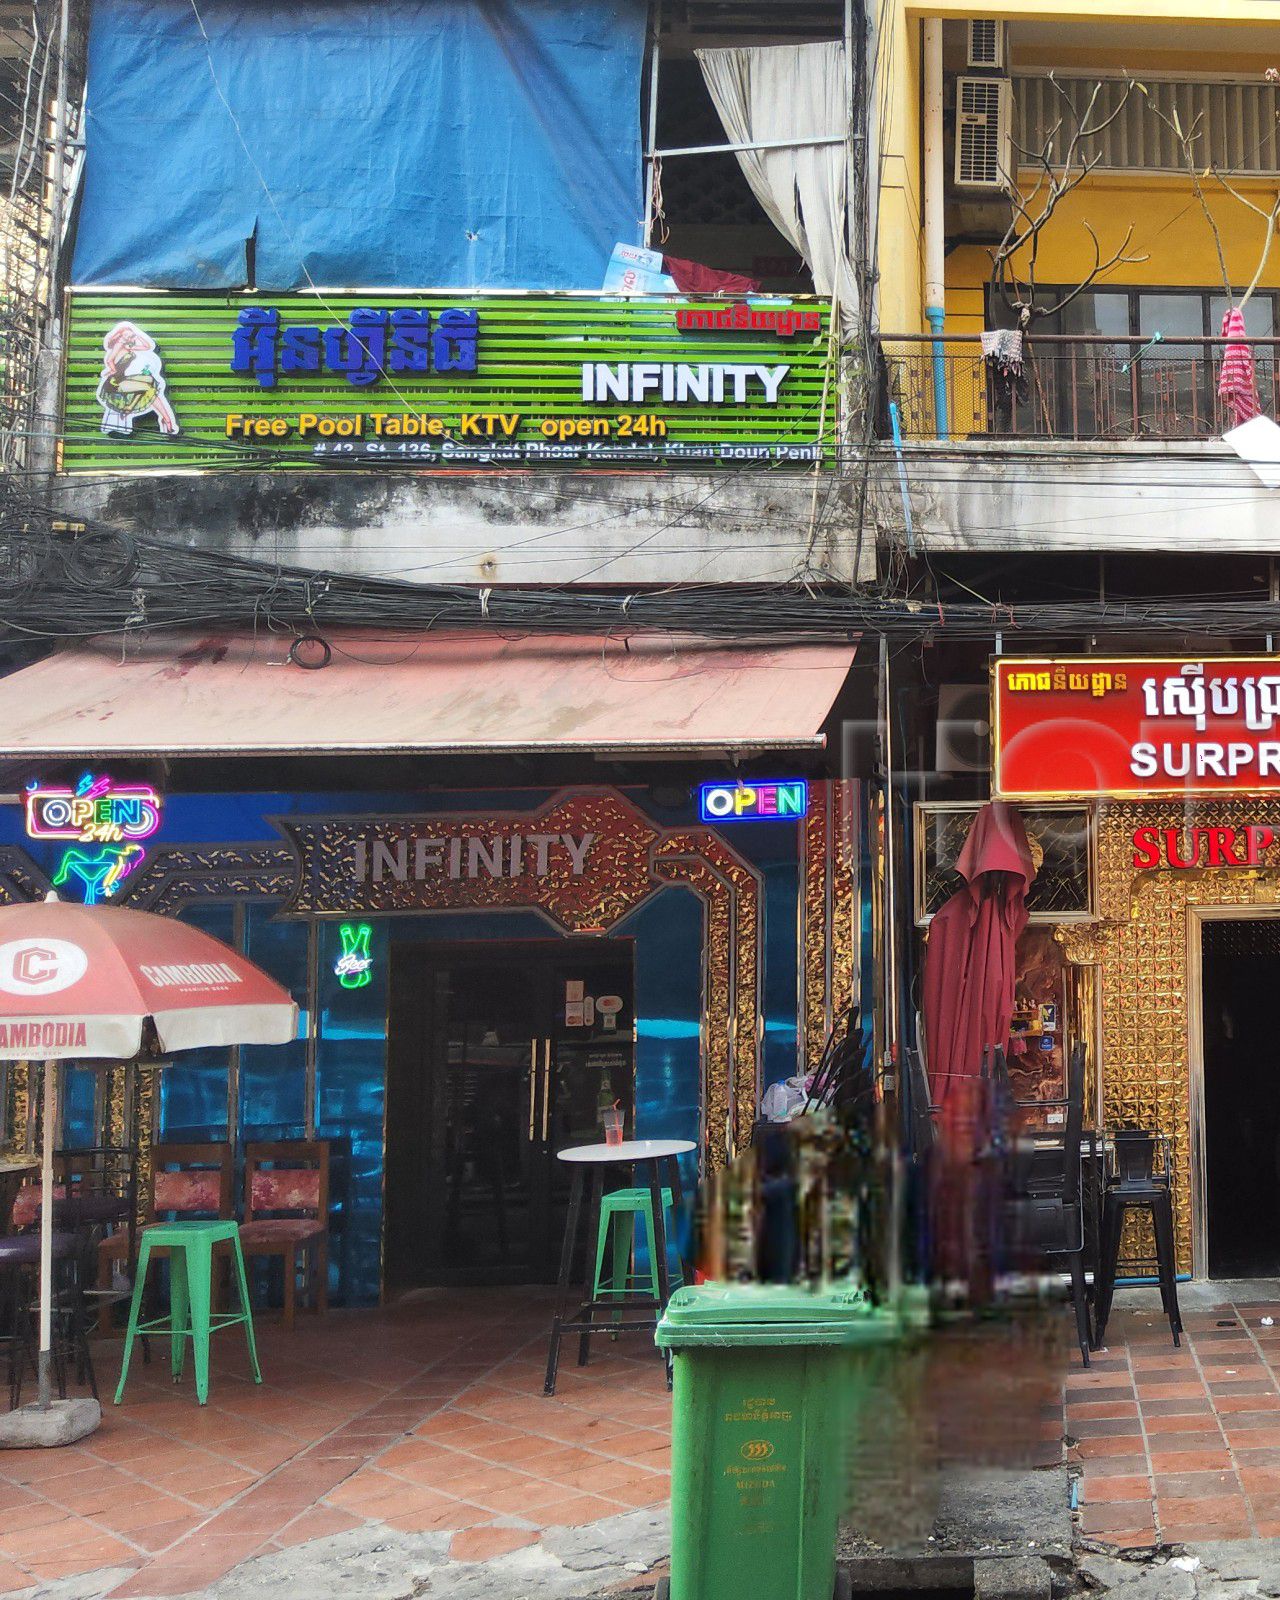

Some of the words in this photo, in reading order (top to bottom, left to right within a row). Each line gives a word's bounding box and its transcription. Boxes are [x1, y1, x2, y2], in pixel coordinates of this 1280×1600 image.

[582, 363, 790, 403] INFINITY
[226, 414, 286, 436] Free
[299, 414, 362, 437] Pool
[370, 414, 451, 438] Table,
[461, 414, 519, 435] KTV
[541, 417, 609, 441] open
[617, 415, 666, 436] 24h
[42, 799, 140, 826] OPEN
[706, 785, 802, 817] OPEN
[355, 834, 595, 882] INFINITY
[139, 963, 243, 987] CAMBODIA
